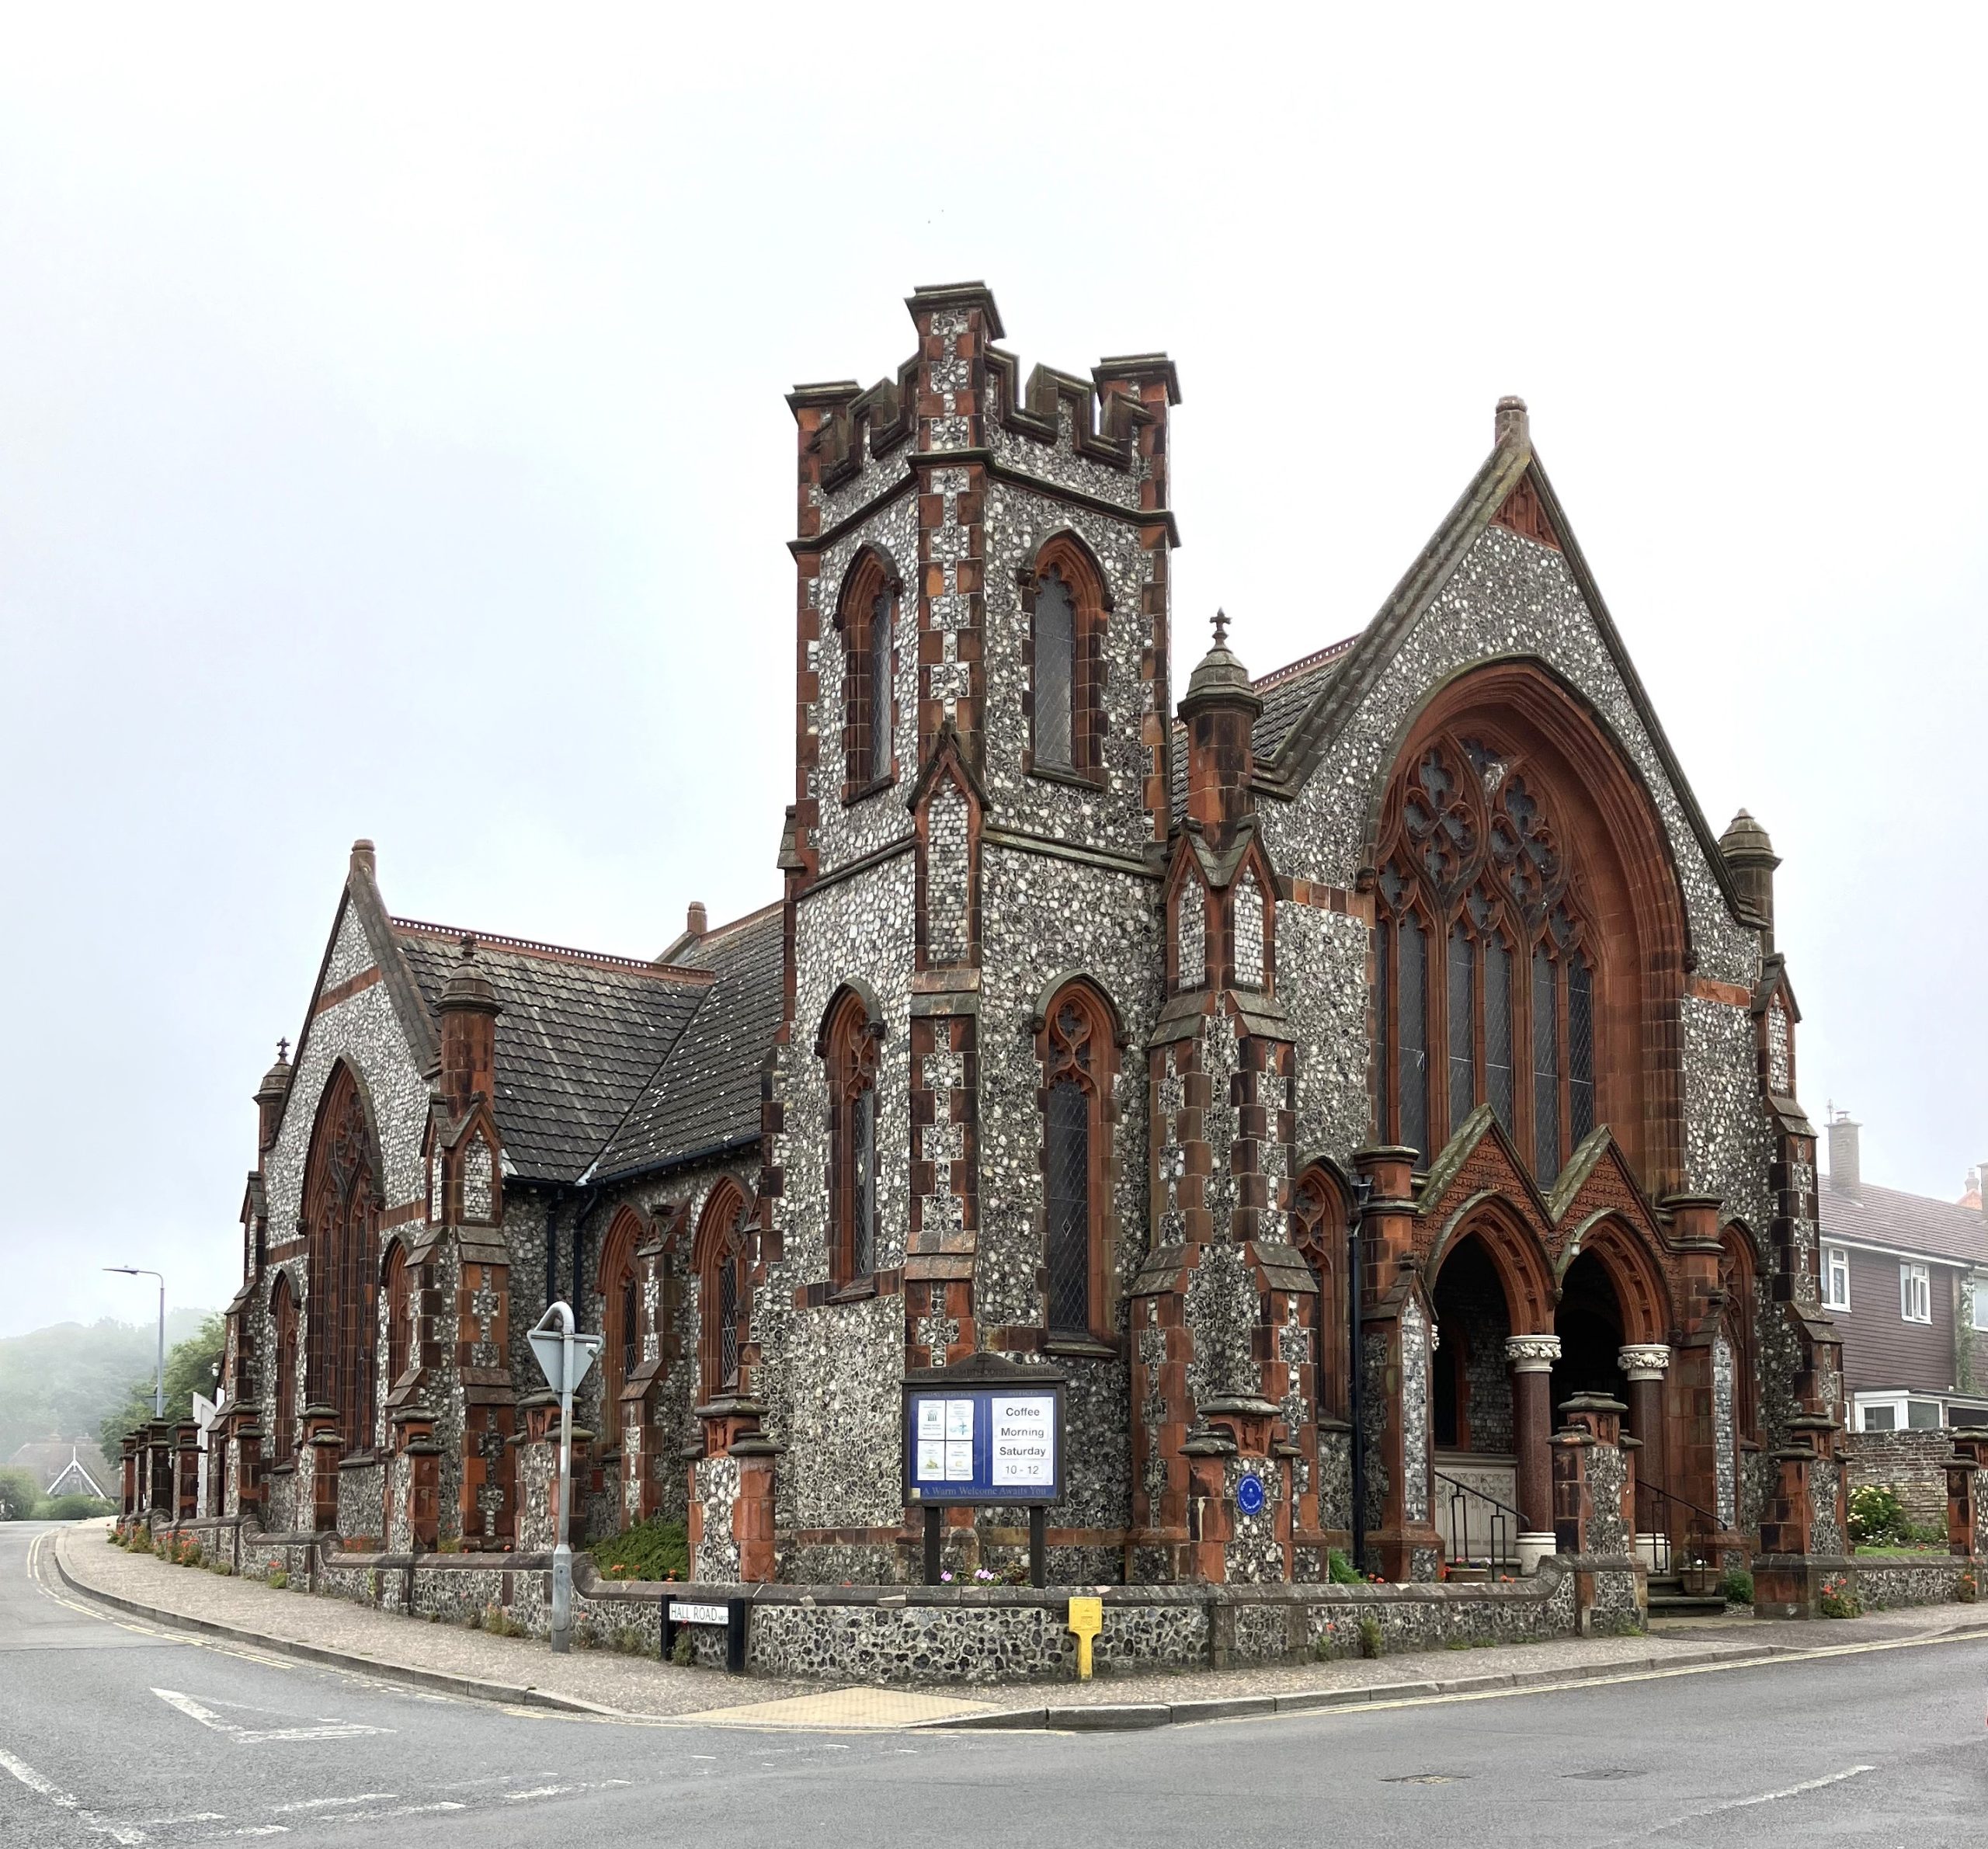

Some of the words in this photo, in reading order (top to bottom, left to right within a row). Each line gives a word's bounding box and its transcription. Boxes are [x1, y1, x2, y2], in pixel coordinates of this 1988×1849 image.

[958, 1368, 1007, 1377] METHODIST
[1006, 1407, 1040, 1416] Coffee
[1001, 1427, 1044, 1438] Morning
[999, 1447, 1046, 1457] Saturday
[1006, 1465, 1017, 1475] 10
[1027, 1465, 1039, 1475] 12
[933, 1486, 957, 1495] Warm
[959, 1486, 996, 1495] Welcome
[999, 1486, 1027, 1495] Awaits
[1029, 1486, 1046, 1495] You
[671, 1604, 690, 1619] HALL
[693, 1606, 718, 1621] ROAD
